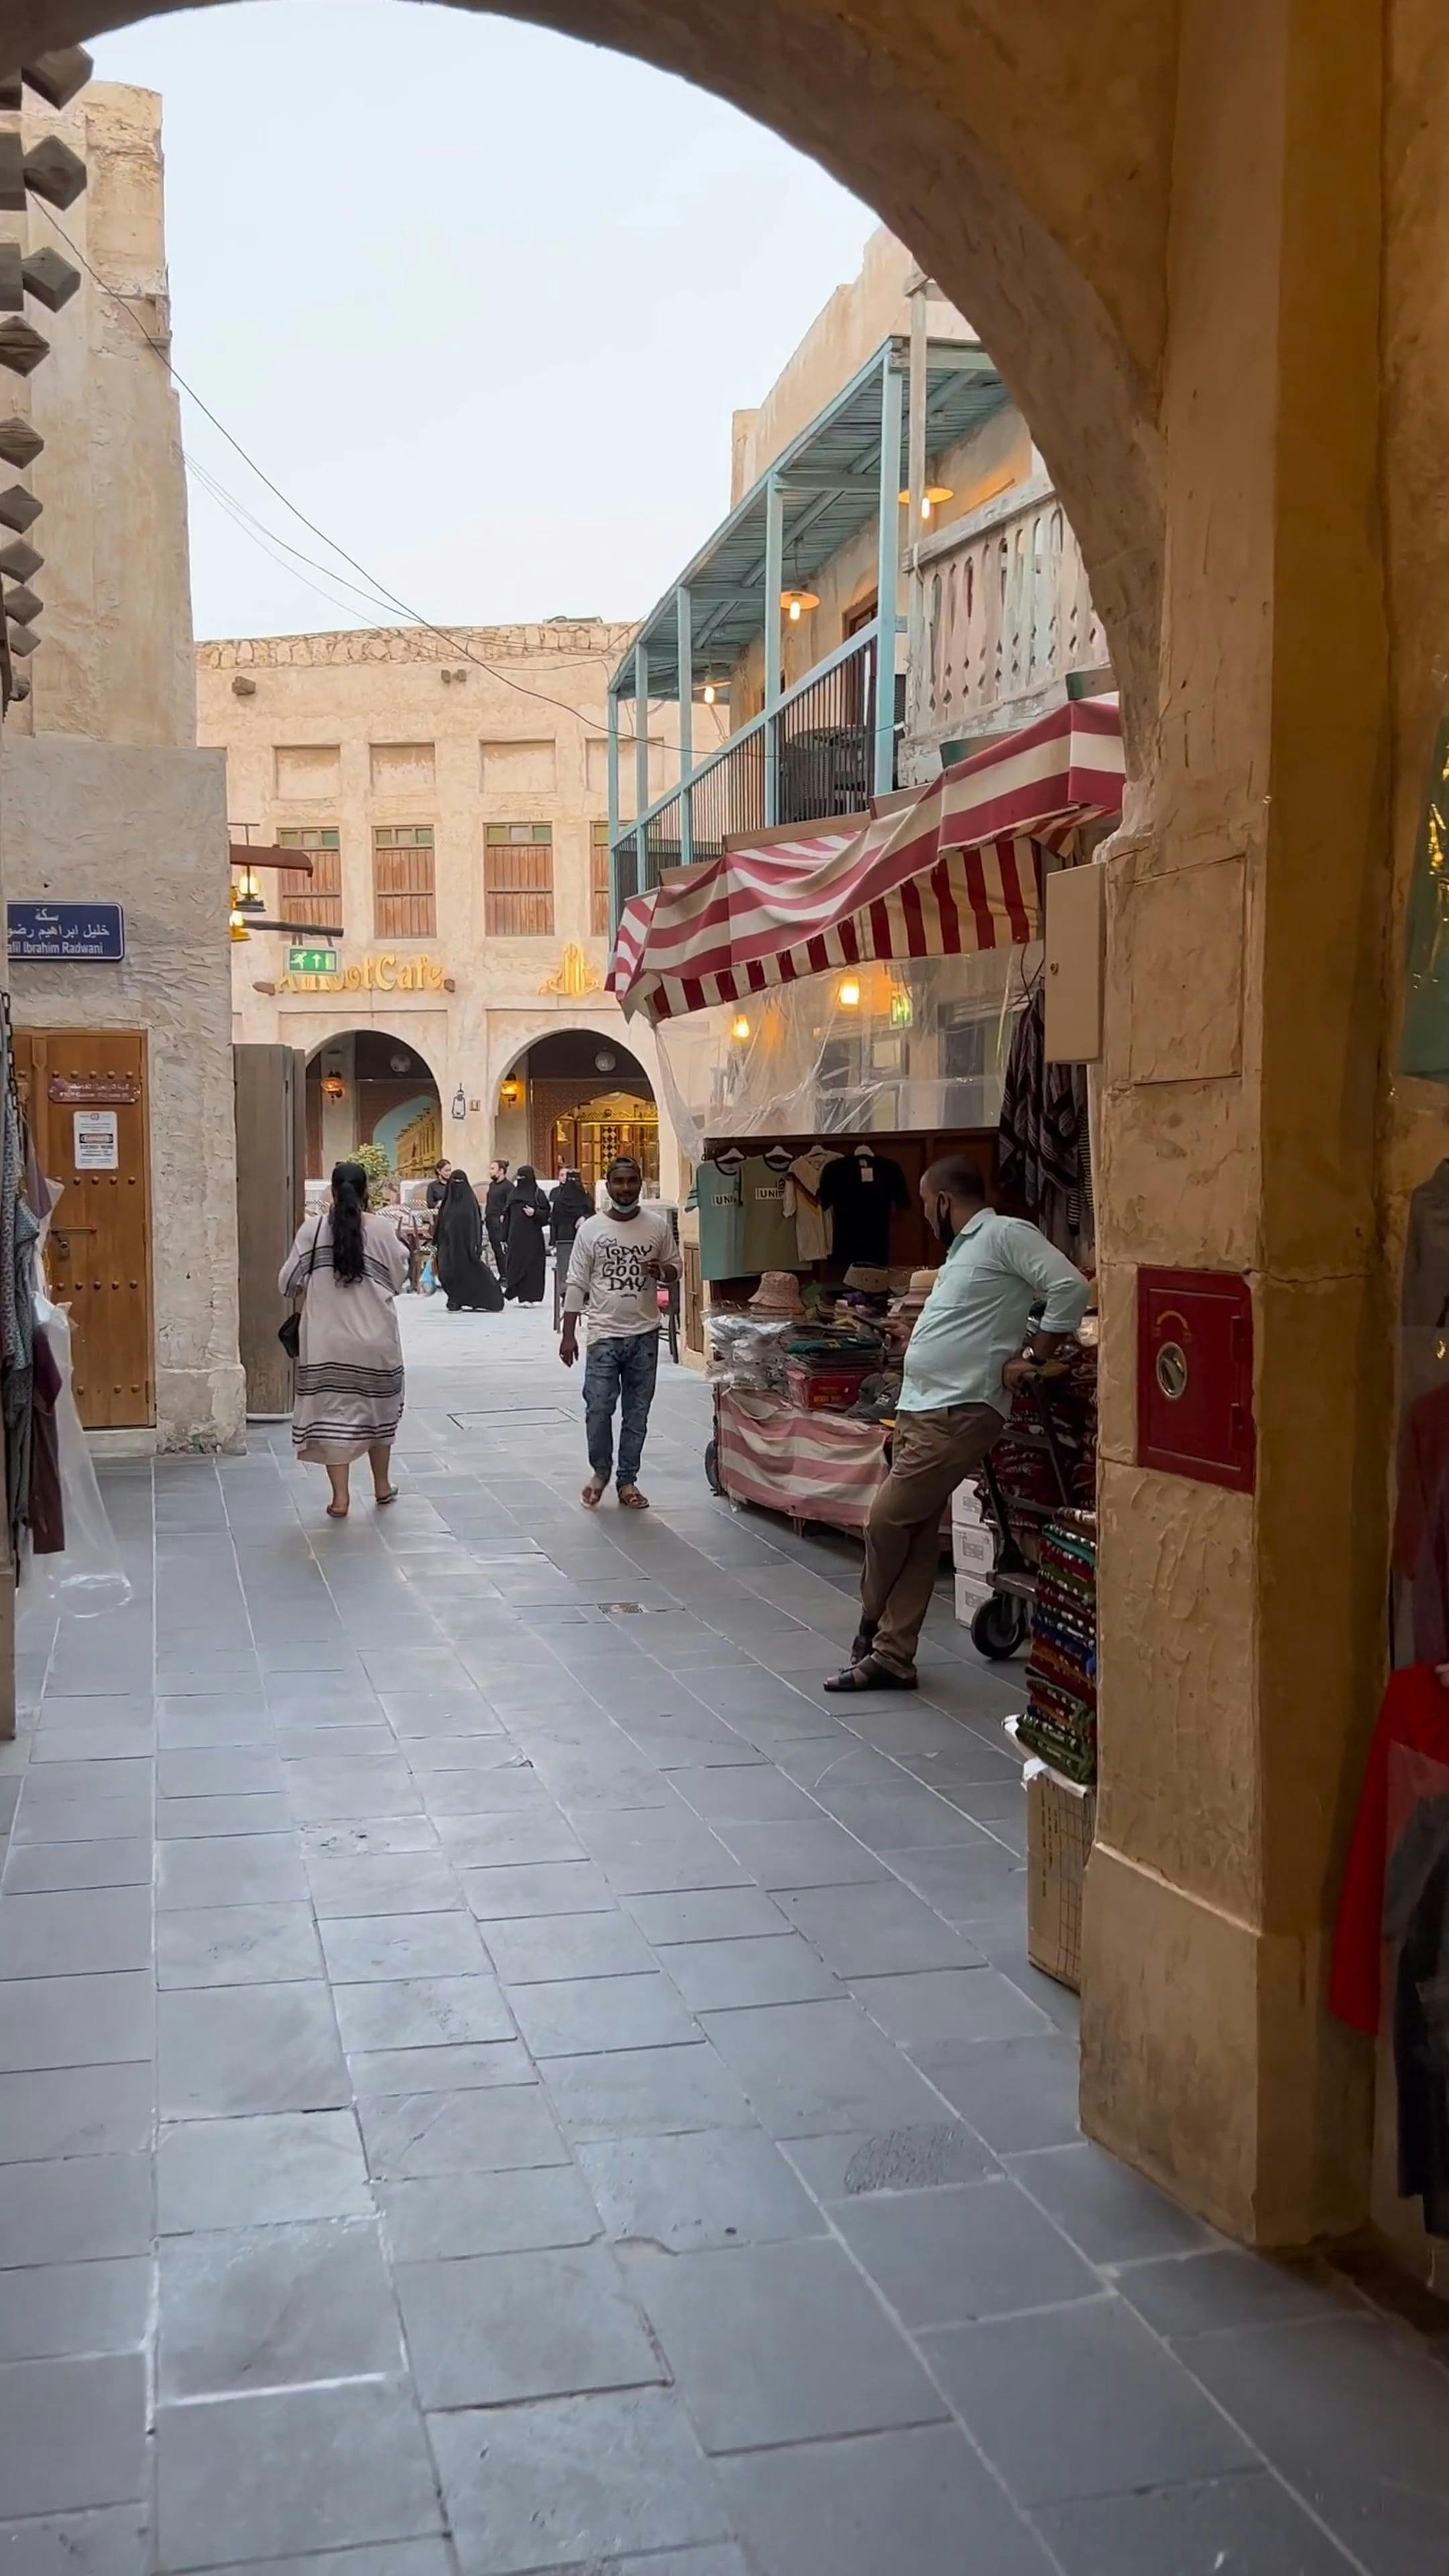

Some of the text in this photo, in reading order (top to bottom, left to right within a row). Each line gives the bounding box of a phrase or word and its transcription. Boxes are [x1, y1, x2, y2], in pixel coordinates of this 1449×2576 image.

[35, 908, 59, 921] سكة
[7, 924, 110, 940] خليل ابراهيم رضو
[7, 941, 103, 955] alil Ibrahim Radwani
[715, 1195, 737, 1205] UNI
[760, 1189, 783, 1199] UNI
[616, 1254, 639, 1265] IS A
[602, 1261, 640, 1277] GOO
